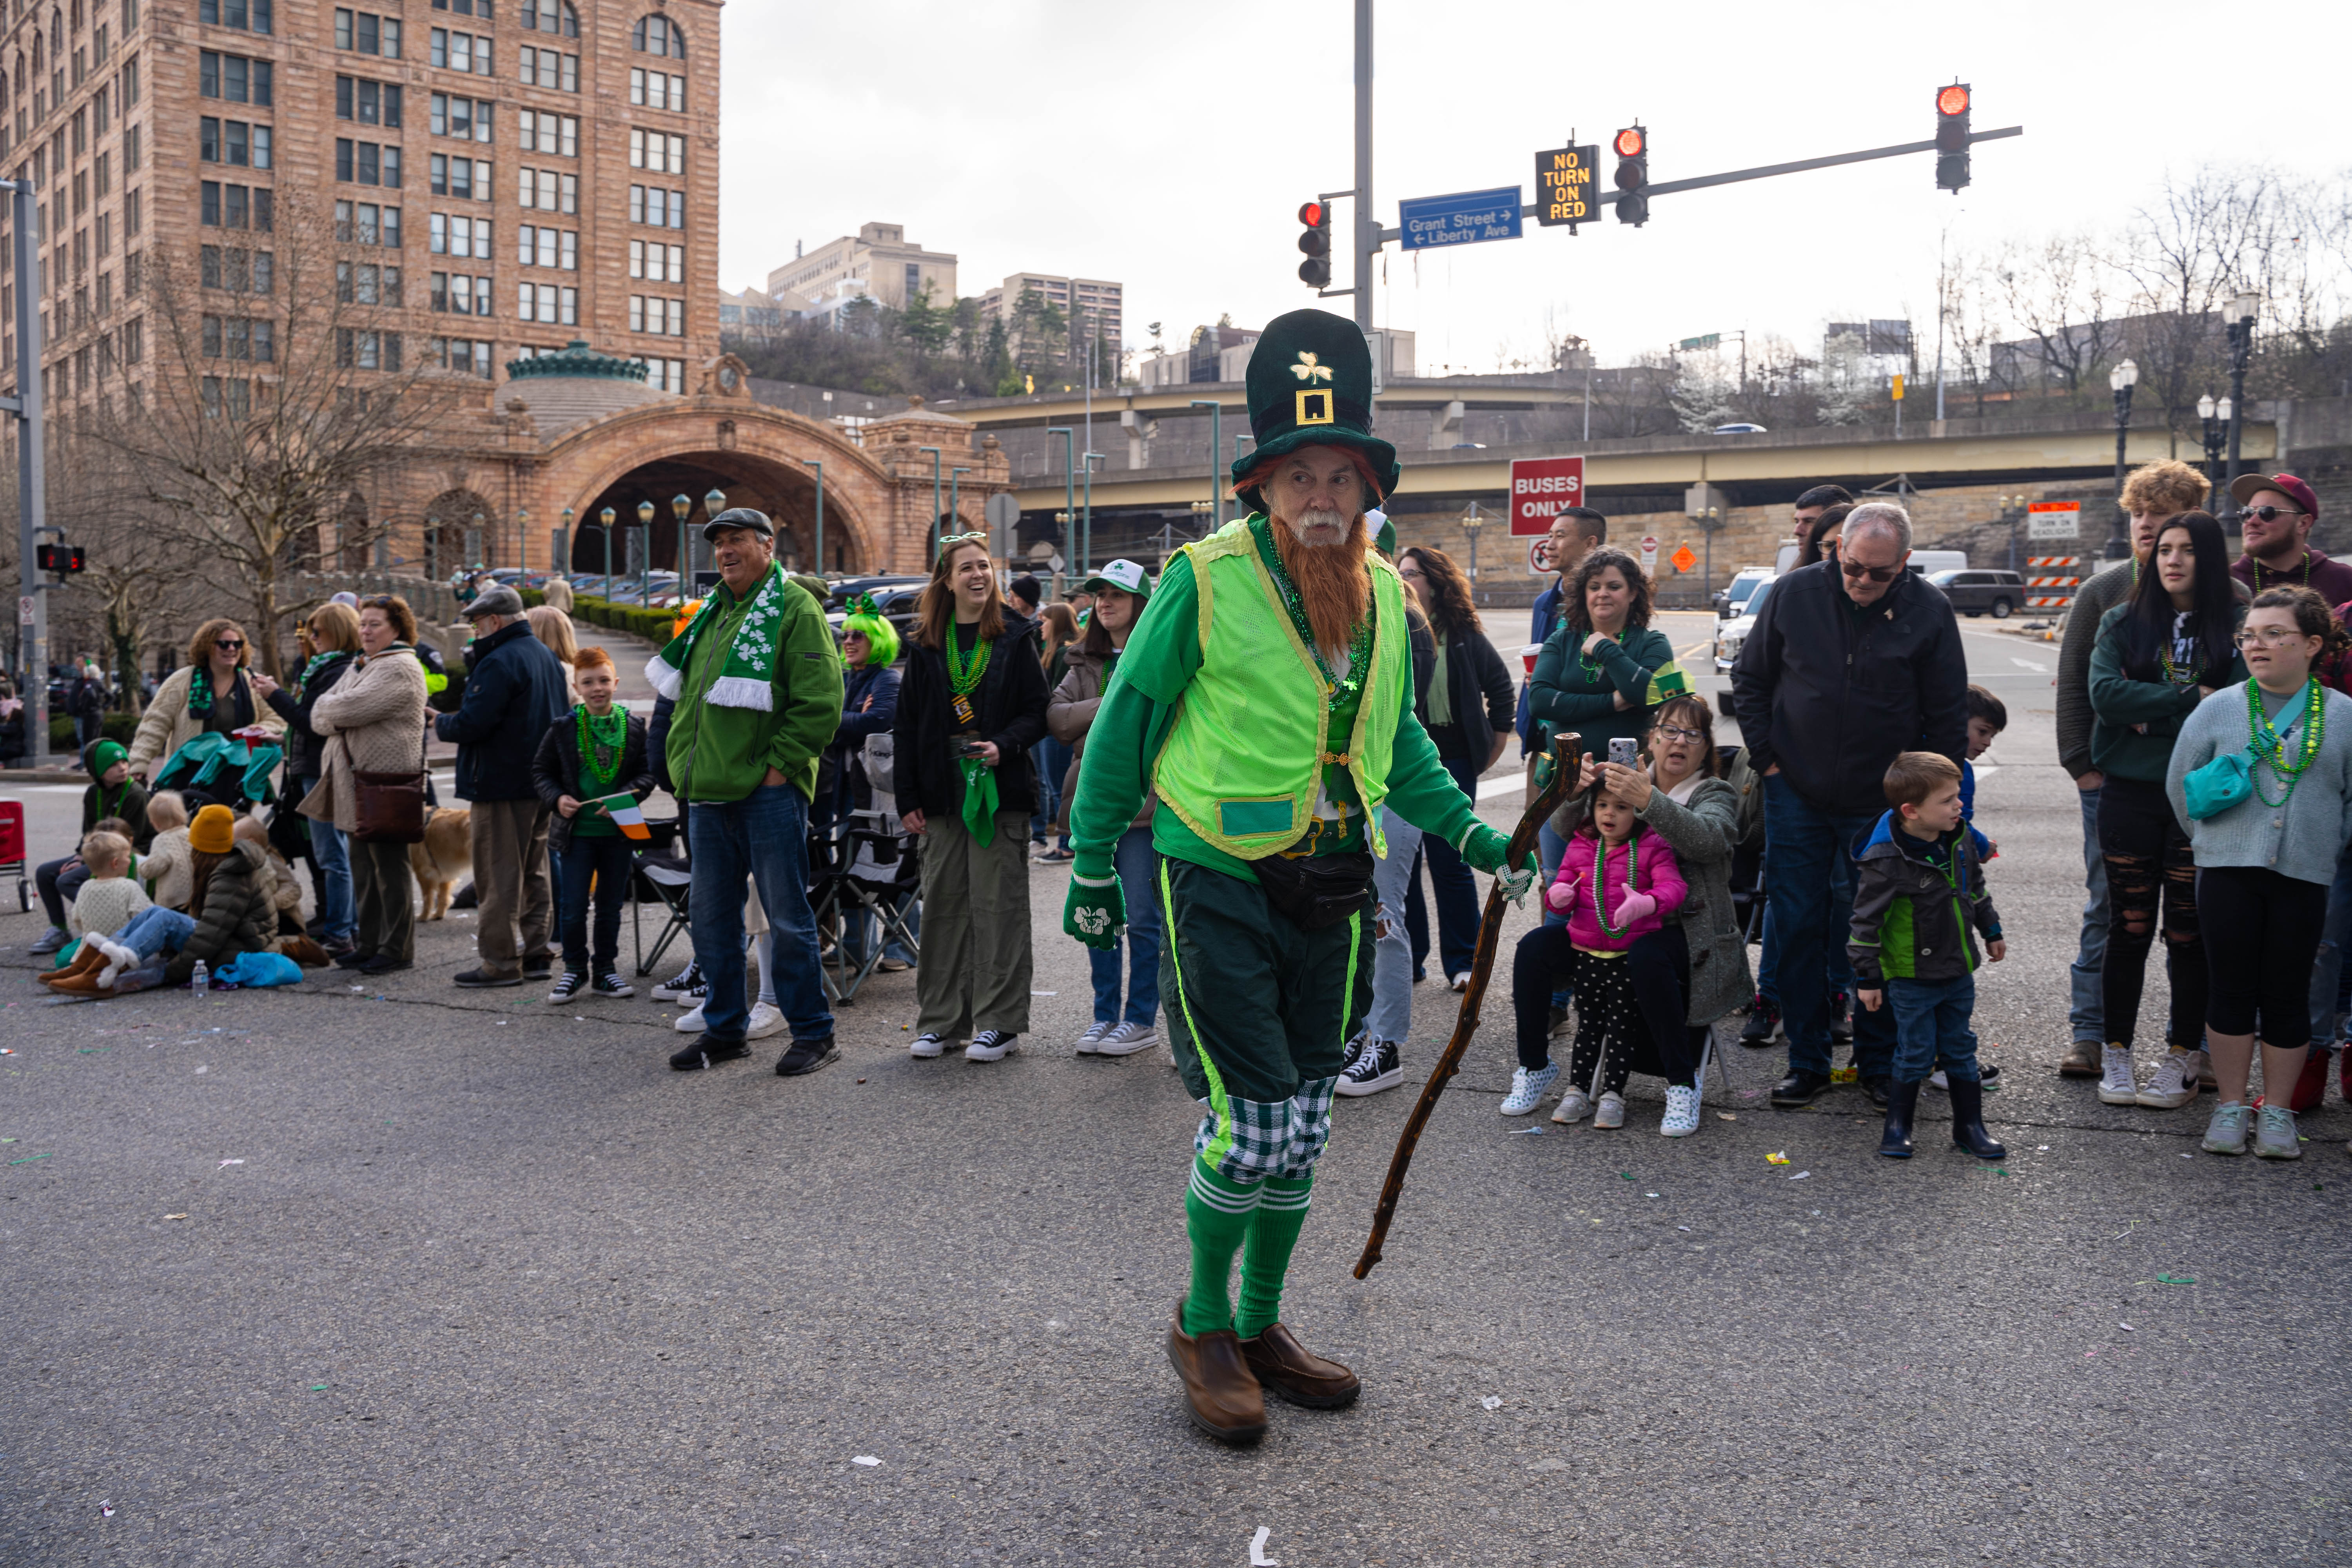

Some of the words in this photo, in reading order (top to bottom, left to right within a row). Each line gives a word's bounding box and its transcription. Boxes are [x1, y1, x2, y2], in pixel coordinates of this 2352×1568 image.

[1554, 152, 1578, 170] NO
[1543, 167, 1590, 187] TURN
[1555, 185, 1579, 202] ON
[1550, 201, 1586, 219] RED
[1409, 218, 1446, 232] Grant
[1454, 211, 1496, 227] Street
[1428, 228, 1476, 244] Liberty
[1484, 225, 1509, 237] Ave
[1515, 475, 1579, 494] BUSES
